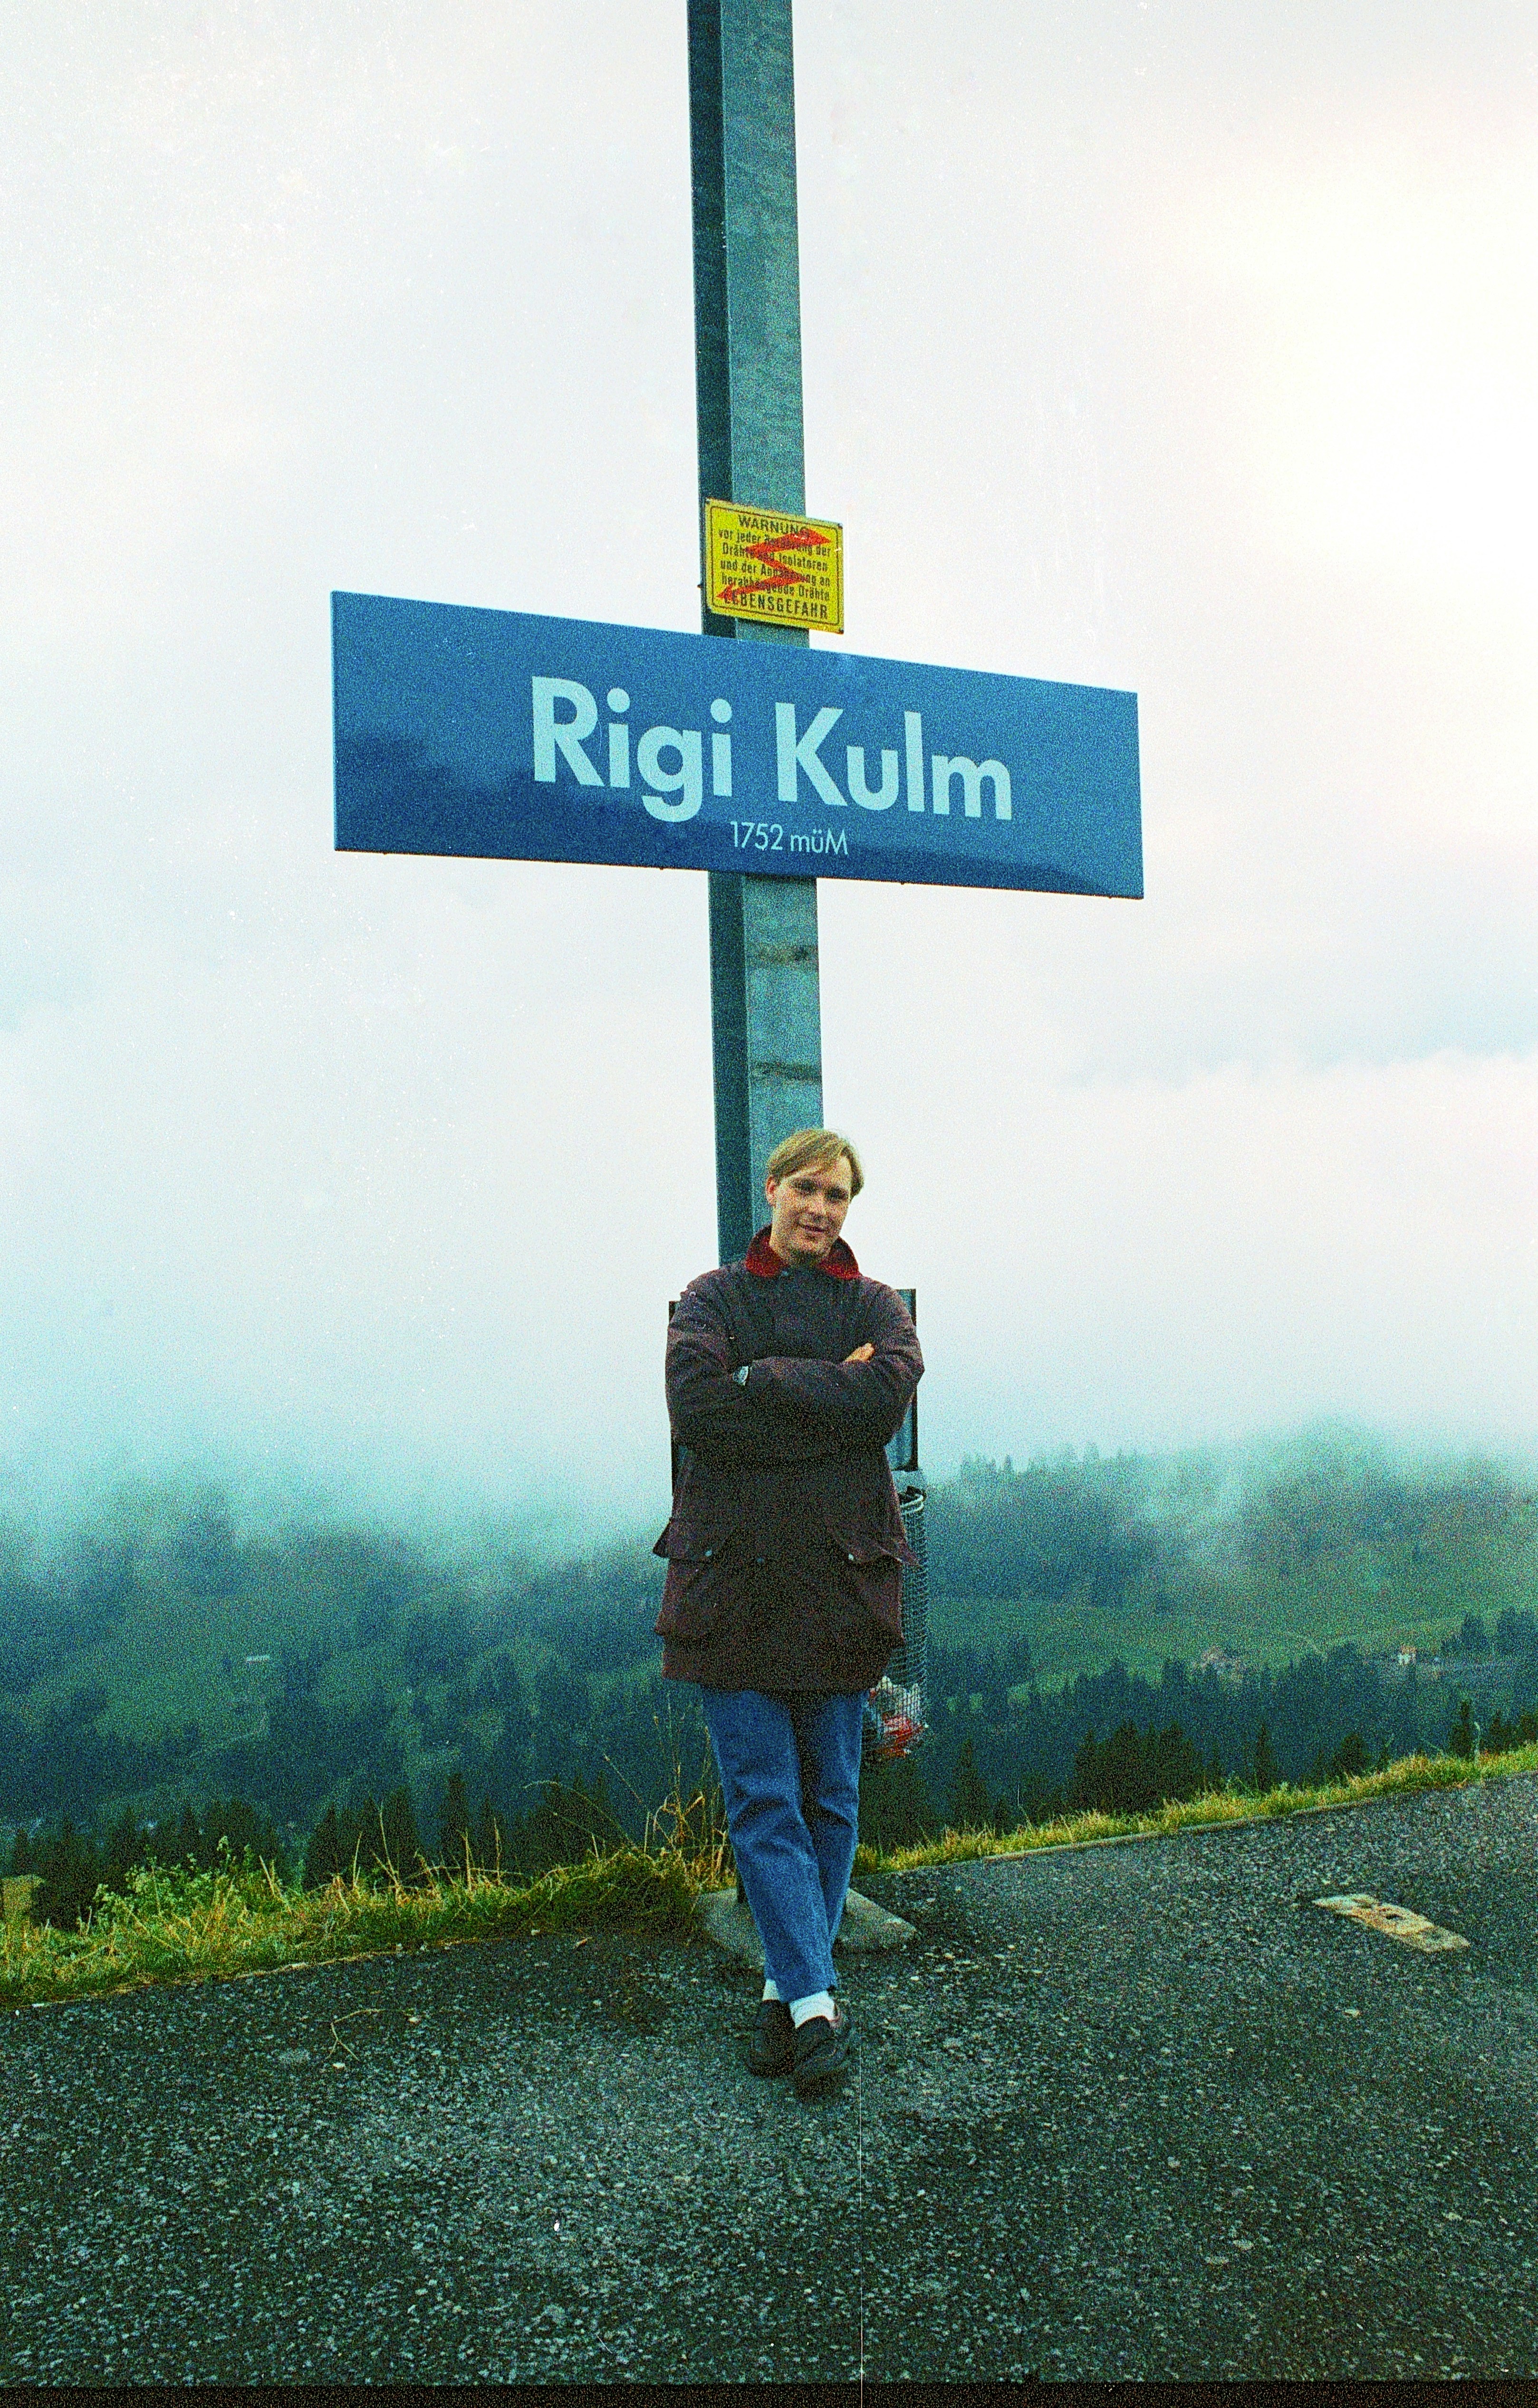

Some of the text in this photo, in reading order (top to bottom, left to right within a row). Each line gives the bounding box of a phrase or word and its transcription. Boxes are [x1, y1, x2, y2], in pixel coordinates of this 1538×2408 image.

[738, 514, 810, 537] WARNUNG
[719, 527, 733, 539] vor
[737, 530, 760, 544] jeder
[816, 543, 831, 556] der
[721, 559, 737, 570] und
[741, 561, 756, 573] der
[819, 577, 830, 587] an
[779, 552, 827, 571] Isolatoren
[723, 588, 827, 619] LEBENSGEFAHR
[798, 585, 829, 602] Drähte
[532, 676, 1012, 823] Rigi Kulm
[730, 821, 848, 855] 1752 müM
